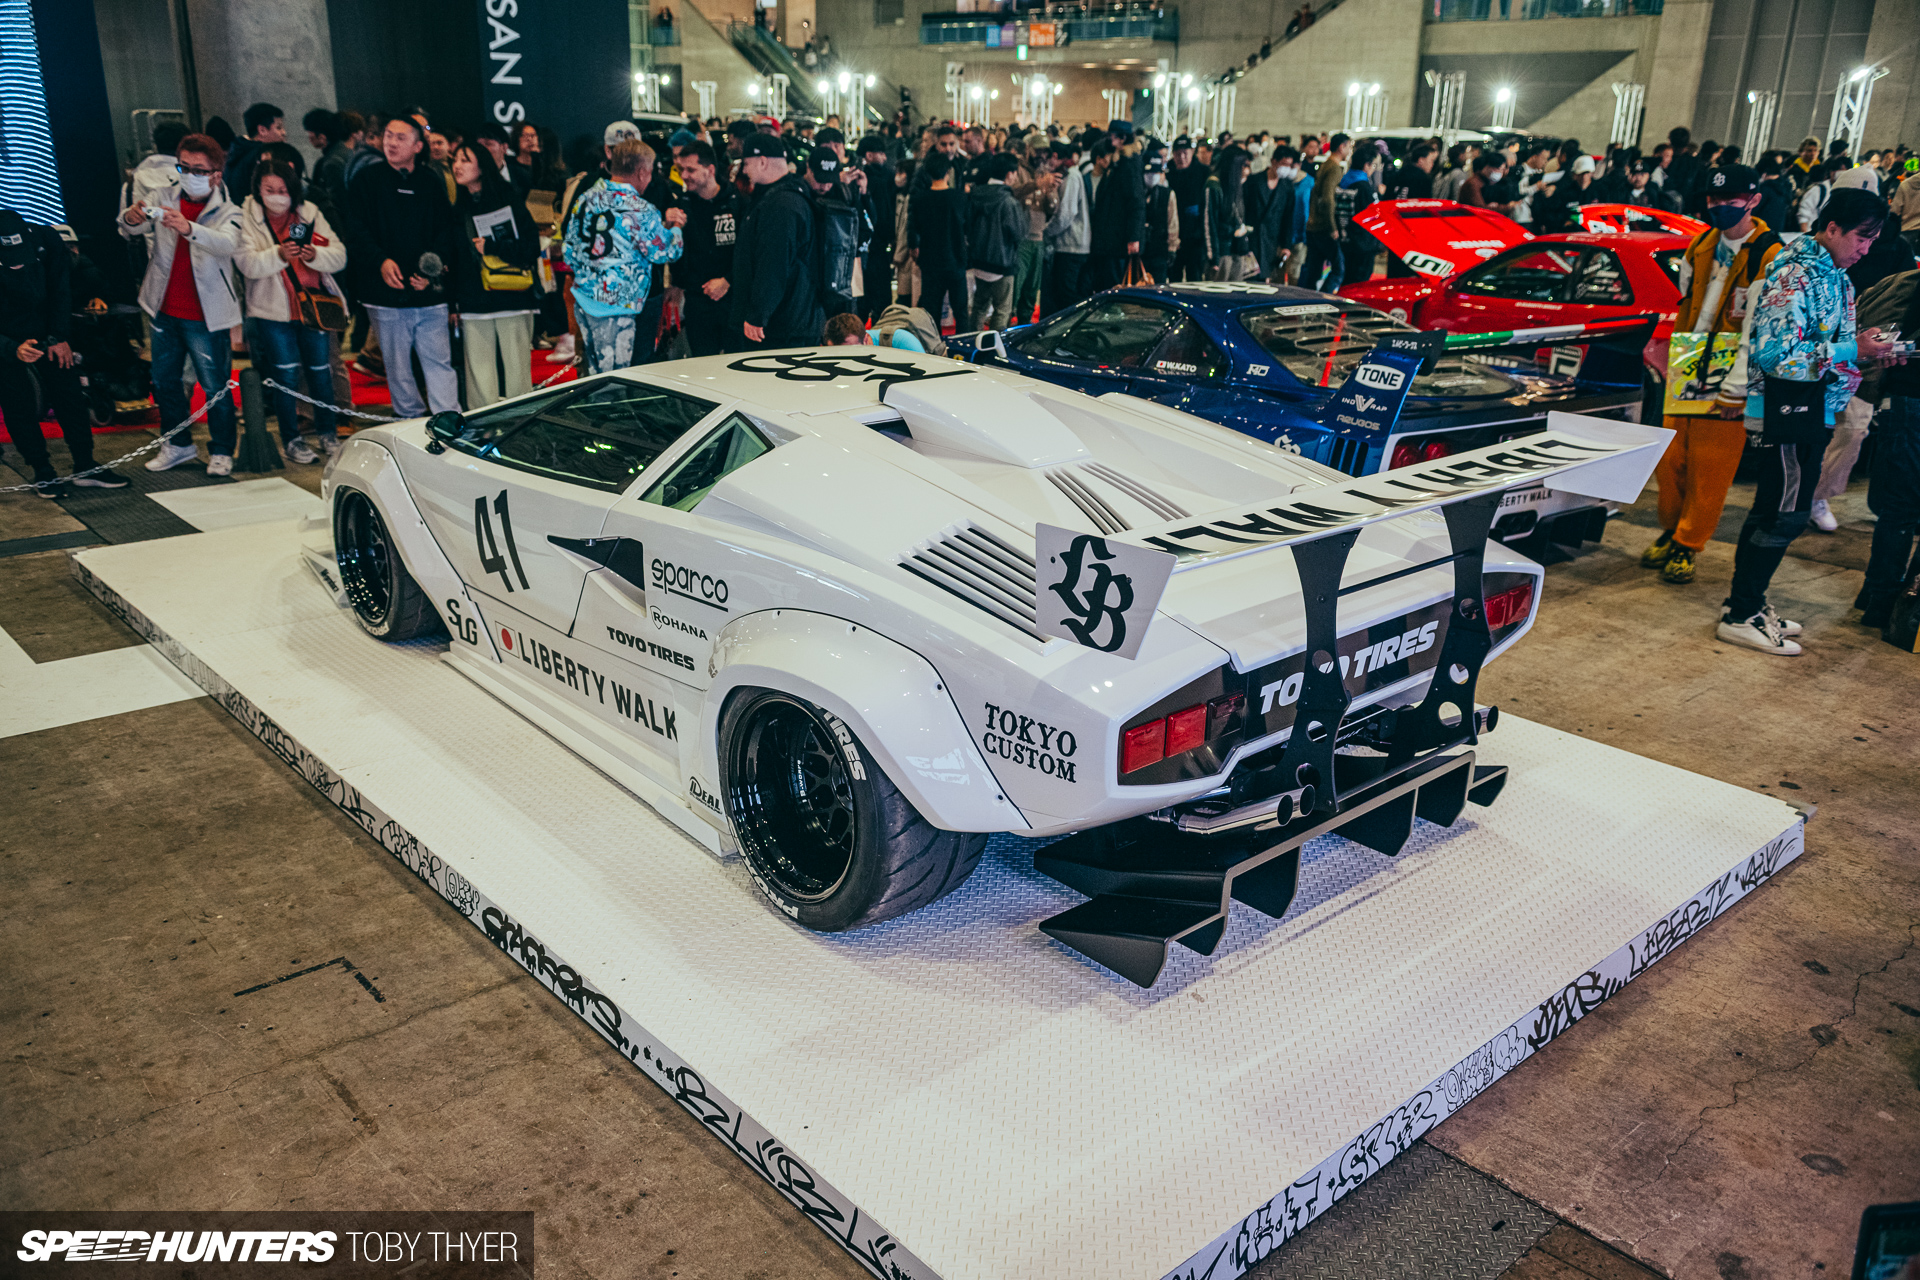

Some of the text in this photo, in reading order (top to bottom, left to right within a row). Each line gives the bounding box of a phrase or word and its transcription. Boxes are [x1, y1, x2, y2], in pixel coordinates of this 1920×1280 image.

[1362, 367, 1401, 387] TONE
[1530, 489, 1553, 501] WALK
[475, 489, 531, 593] 41
[652, 558, 729, 604] sparco
[606, 626, 696, 671] TOYO TIRES
[653, 610, 708, 641] ROHANA
[1354, 620, 1439, 679] TIRES
[518, 632, 679, 743] LIBERTY WALK
[984, 702, 1077, 758] TOKYO
[983, 732, 1077, 784] CUSTOM
